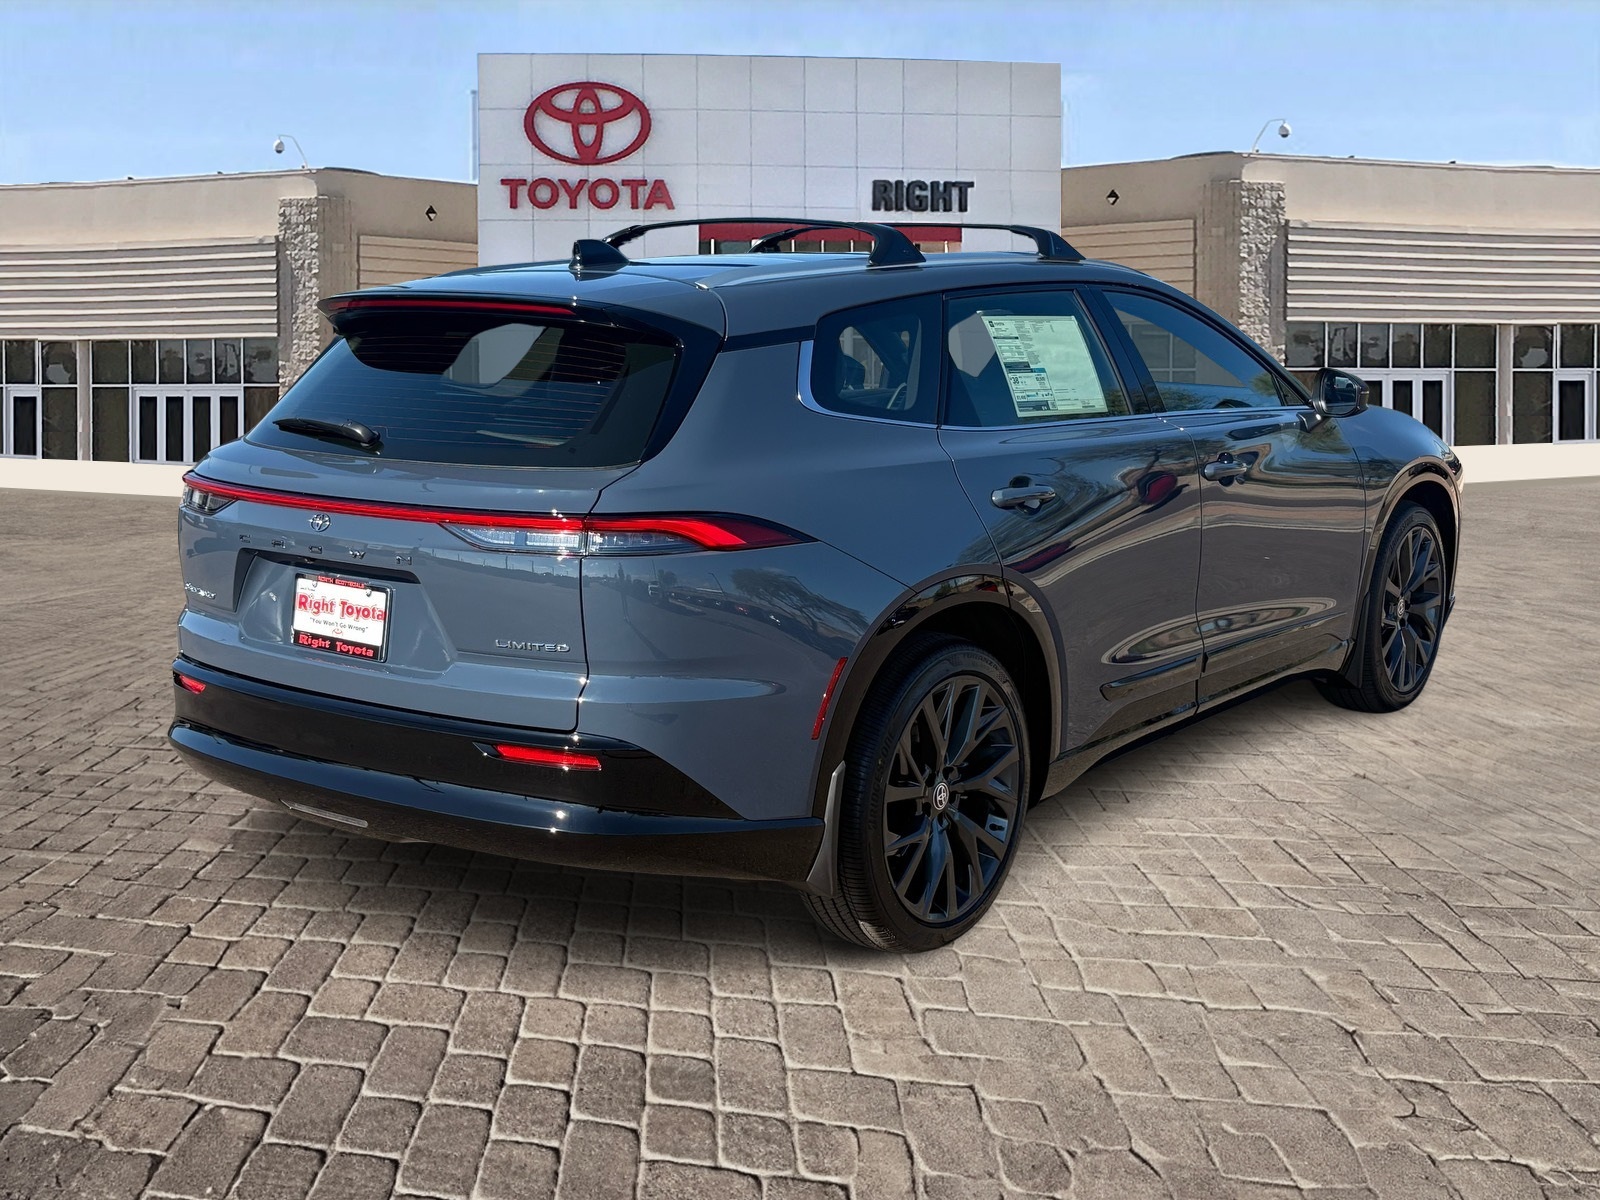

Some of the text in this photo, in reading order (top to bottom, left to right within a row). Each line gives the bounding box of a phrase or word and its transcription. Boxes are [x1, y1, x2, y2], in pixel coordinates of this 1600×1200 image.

[500, 177, 675, 210] TOYOTA
[871, 178, 975, 212] RIGHT
[297, 594, 385, 620] Right Toyota
[323, 619, 339, 628] Won't
[298, 634, 374, 657] Right Toyota
[495, 639, 570, 652] LIMITED
[867, 730, 896, 831] BRIDGESONE
